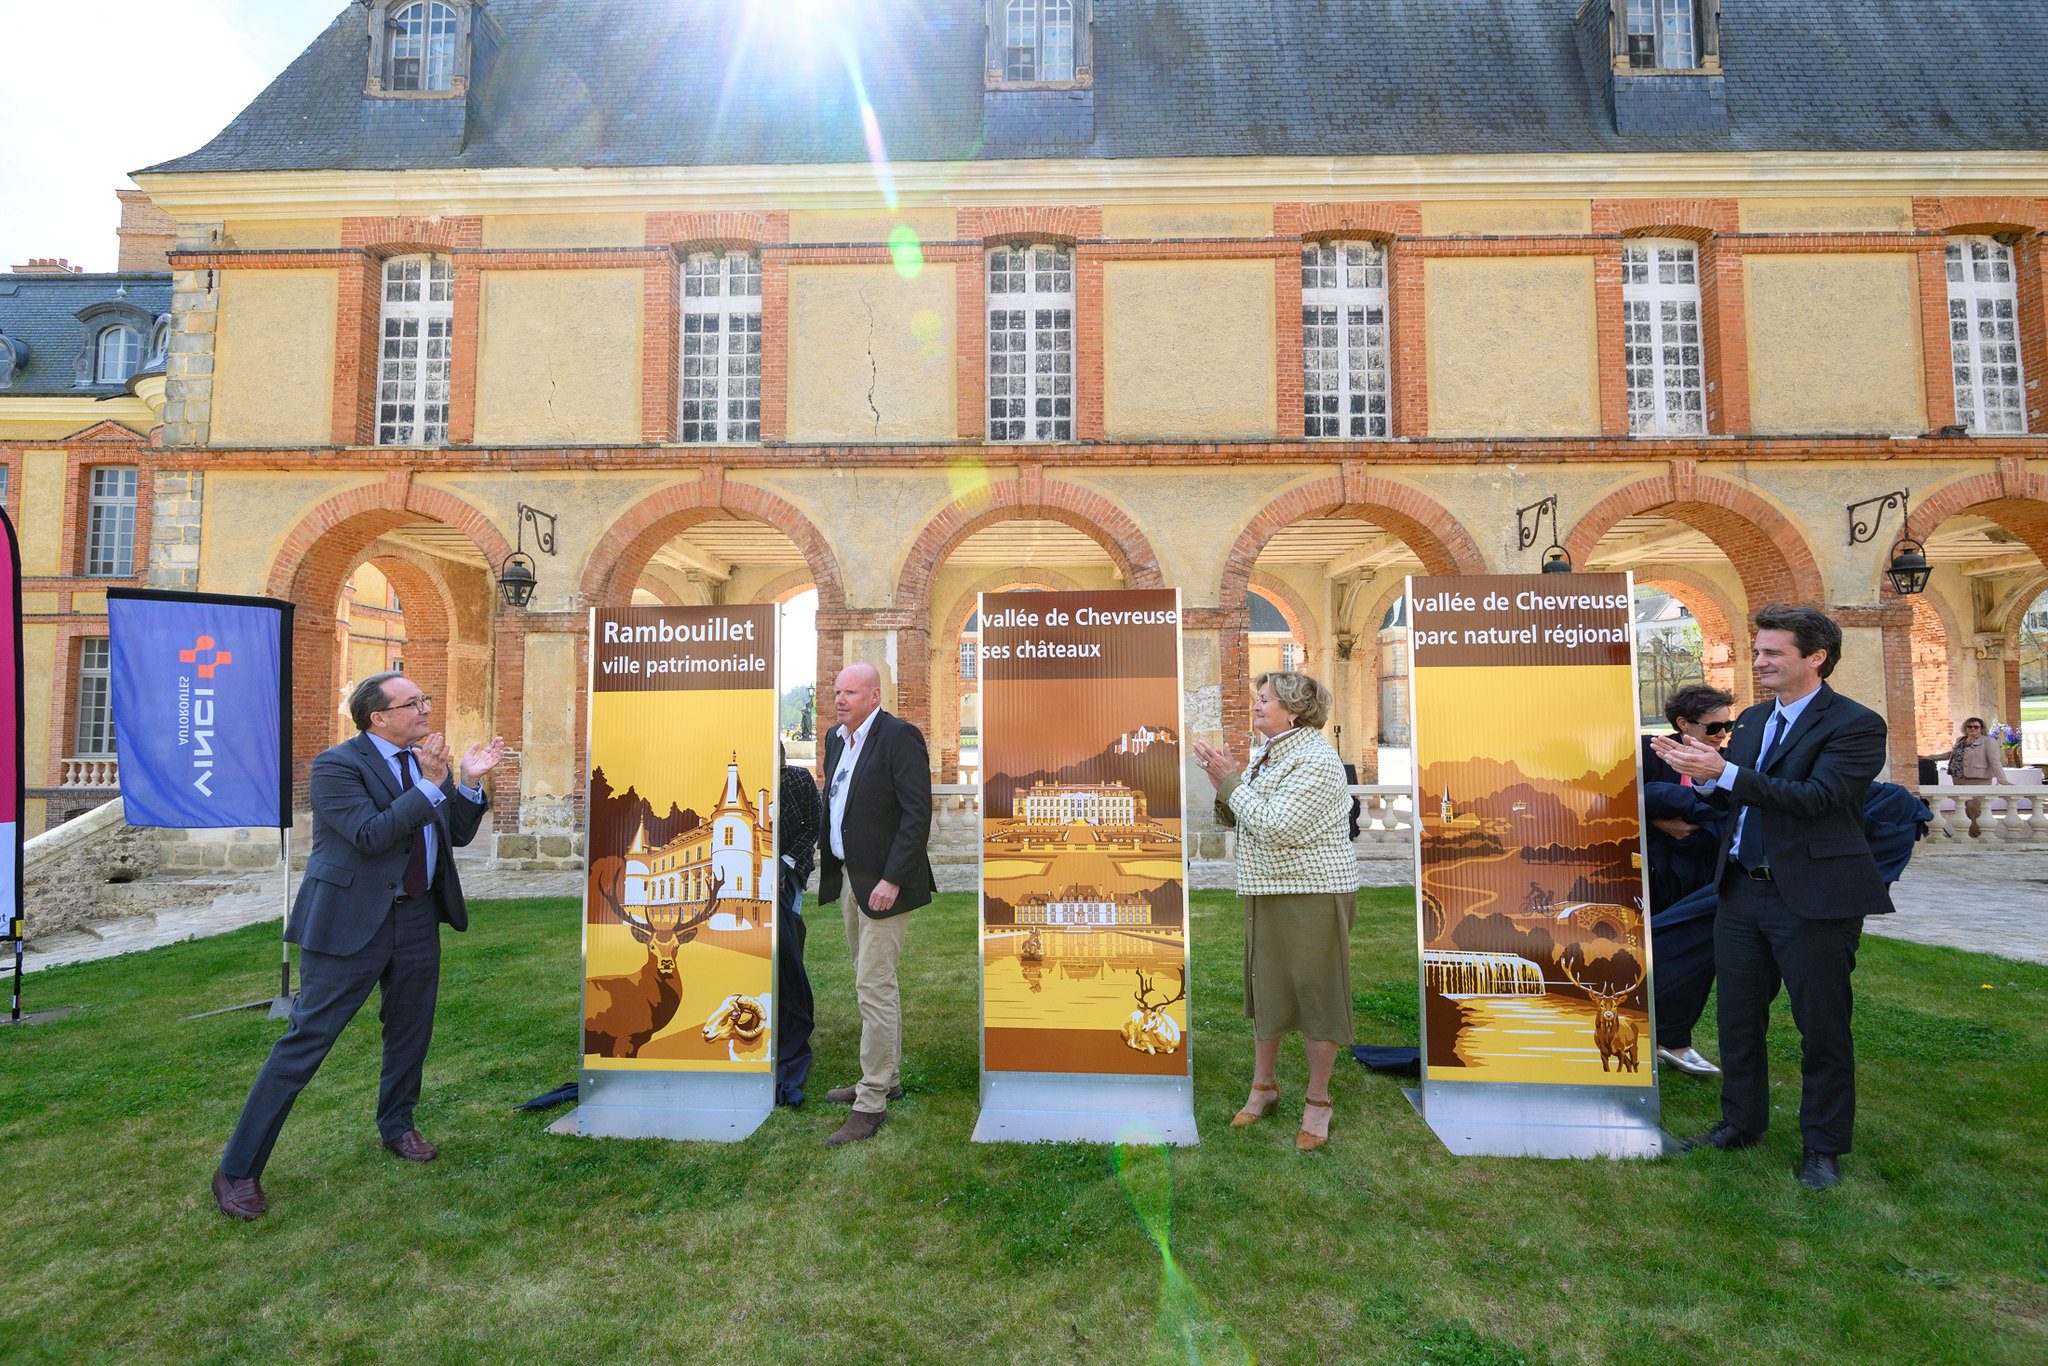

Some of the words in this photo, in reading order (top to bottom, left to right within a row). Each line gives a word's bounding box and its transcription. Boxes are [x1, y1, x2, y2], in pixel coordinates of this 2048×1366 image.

[1412, 592, 1476, 612] vallée
[1482, 591, 1509, 611] de
[1516, 590, 1628, 611] Chevreuse
[982, 608, 1039, 628] vallée
[1045, 608, 1069, 627] de
[1075, 607, 1177, 626] Chevreuse
[604, 617, 755, 644] Rambouillet
[1414, 629, 1458, 650] parc
[1464, 625, 1537, 645] naturel
[1544, 623, 1630, 648] régional
[981, 644, 1010, 659] ses
[1016, 640, 1101, 659] châteaux
[602, 656, 640, 674] ville
[646, 653, 766, 678] patrimoniale
